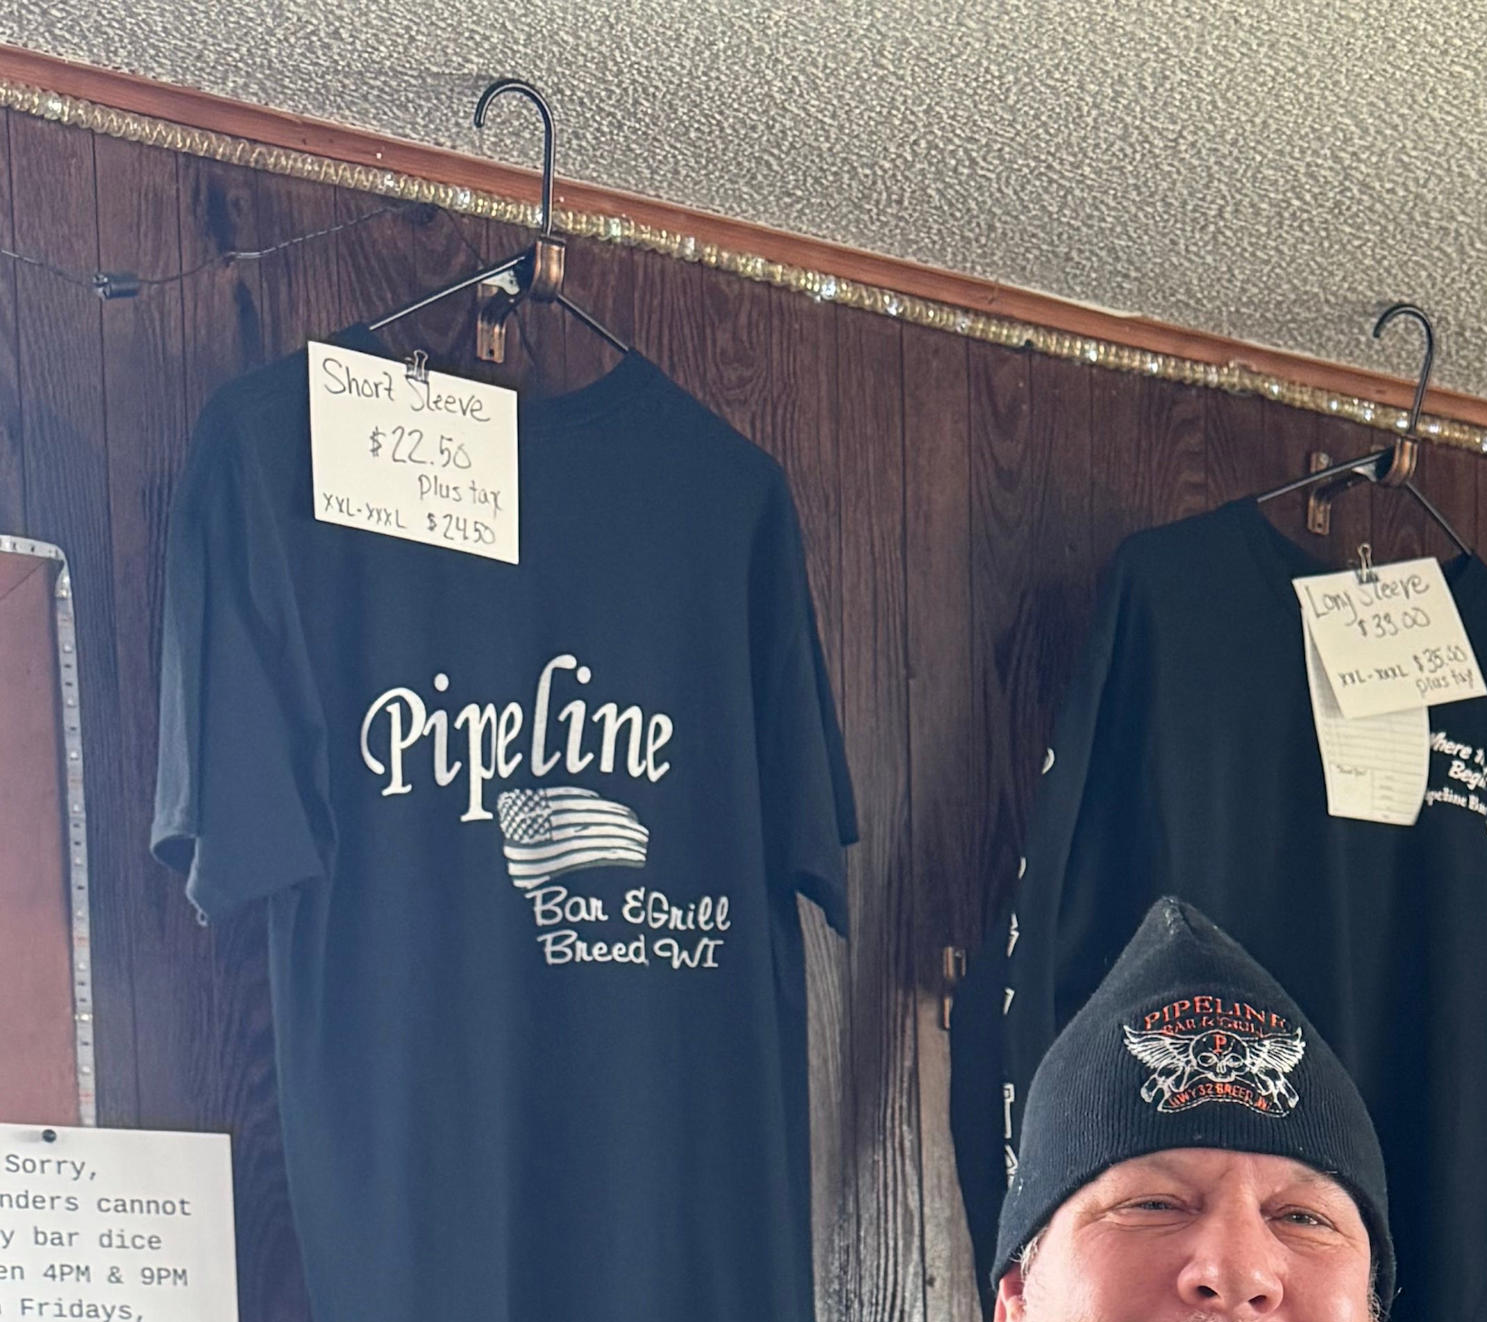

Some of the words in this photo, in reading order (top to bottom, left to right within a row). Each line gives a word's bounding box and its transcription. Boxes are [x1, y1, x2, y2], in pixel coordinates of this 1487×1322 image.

[322, 358, 395, 401] Short
[405, 375, 491, 422] Sleeve
[369, 425, 472, 470] $22.50
[1305, 585, 1358, 626] Long
[360, 654, 673, 822] Pipeline
[525, 886, 608, 927] Bar
[537, 930, 649, 967] Breed
[654, 939, 724, 970] WI
[1143, 995, 1288, 1033] PIPELINE
[5, 1154, 97, 1181] Sorry,
[96, 1196, 192, 1217] cannot
[33, 1226, 79, 1247] bar
[98, 1228, 162, 1250] dice
[43, 1264, 91, 1283] 4PM
[107, 1266, 124, 1285] &
[140, 1267, 188, 1287] 9PM
